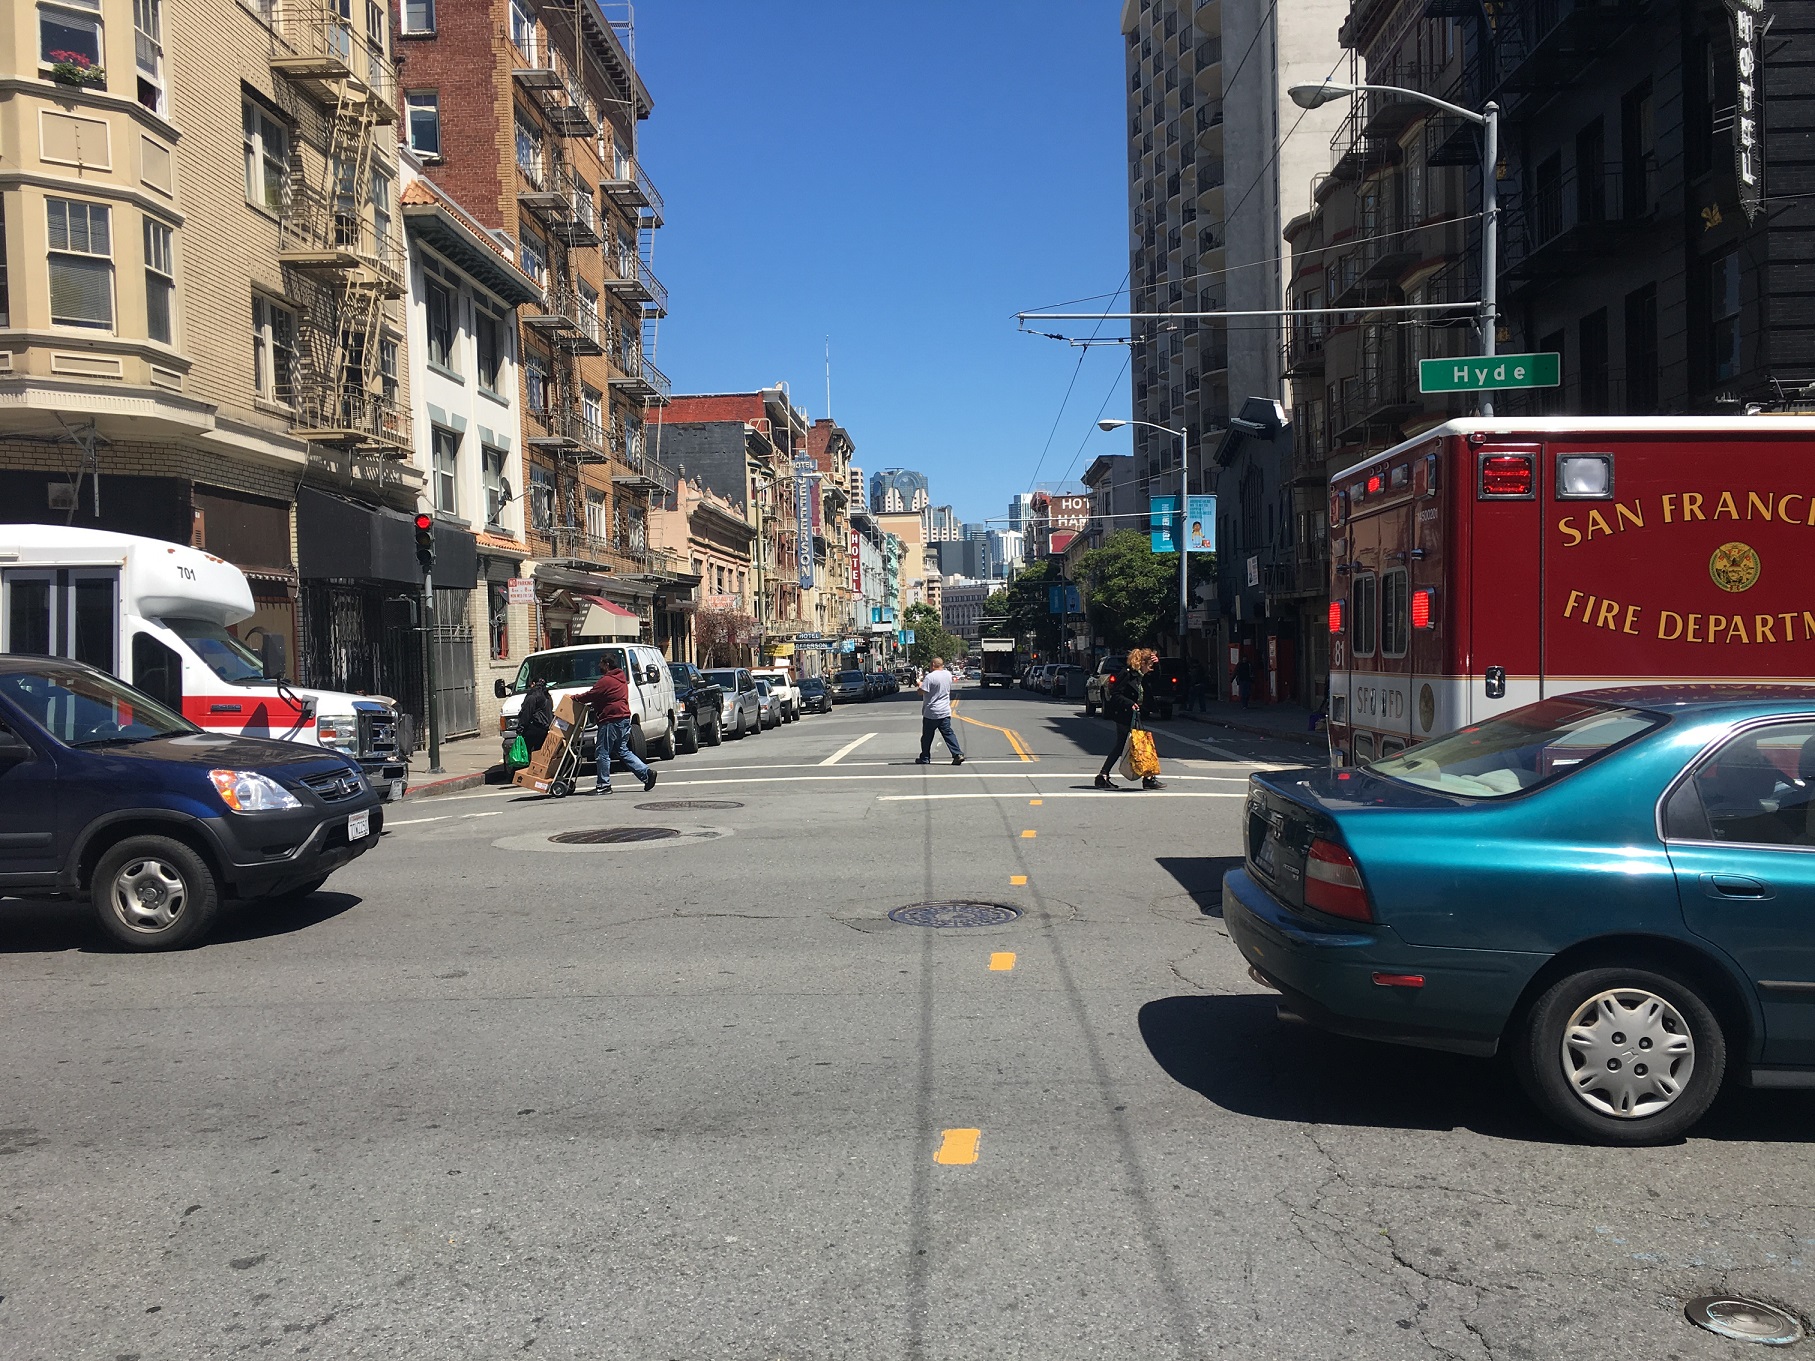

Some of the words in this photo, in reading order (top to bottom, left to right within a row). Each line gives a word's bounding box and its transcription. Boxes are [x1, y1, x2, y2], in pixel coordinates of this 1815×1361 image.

[1738, 10, 1757, 186] HOTEL
[1453, 364, 1526, 386] Hyde
[792, 461, 815, 469] HOTEL
[799, 473, 811, 577] JEFFERSON
[1558, 499, 1645, 547] SAN
[176, 565, 196, 581] 701
[851, 534, 860, 592] HOTEL
[1563, 590, 1641, 635] FIRE
[1334, 640, 1346, 670] 81
